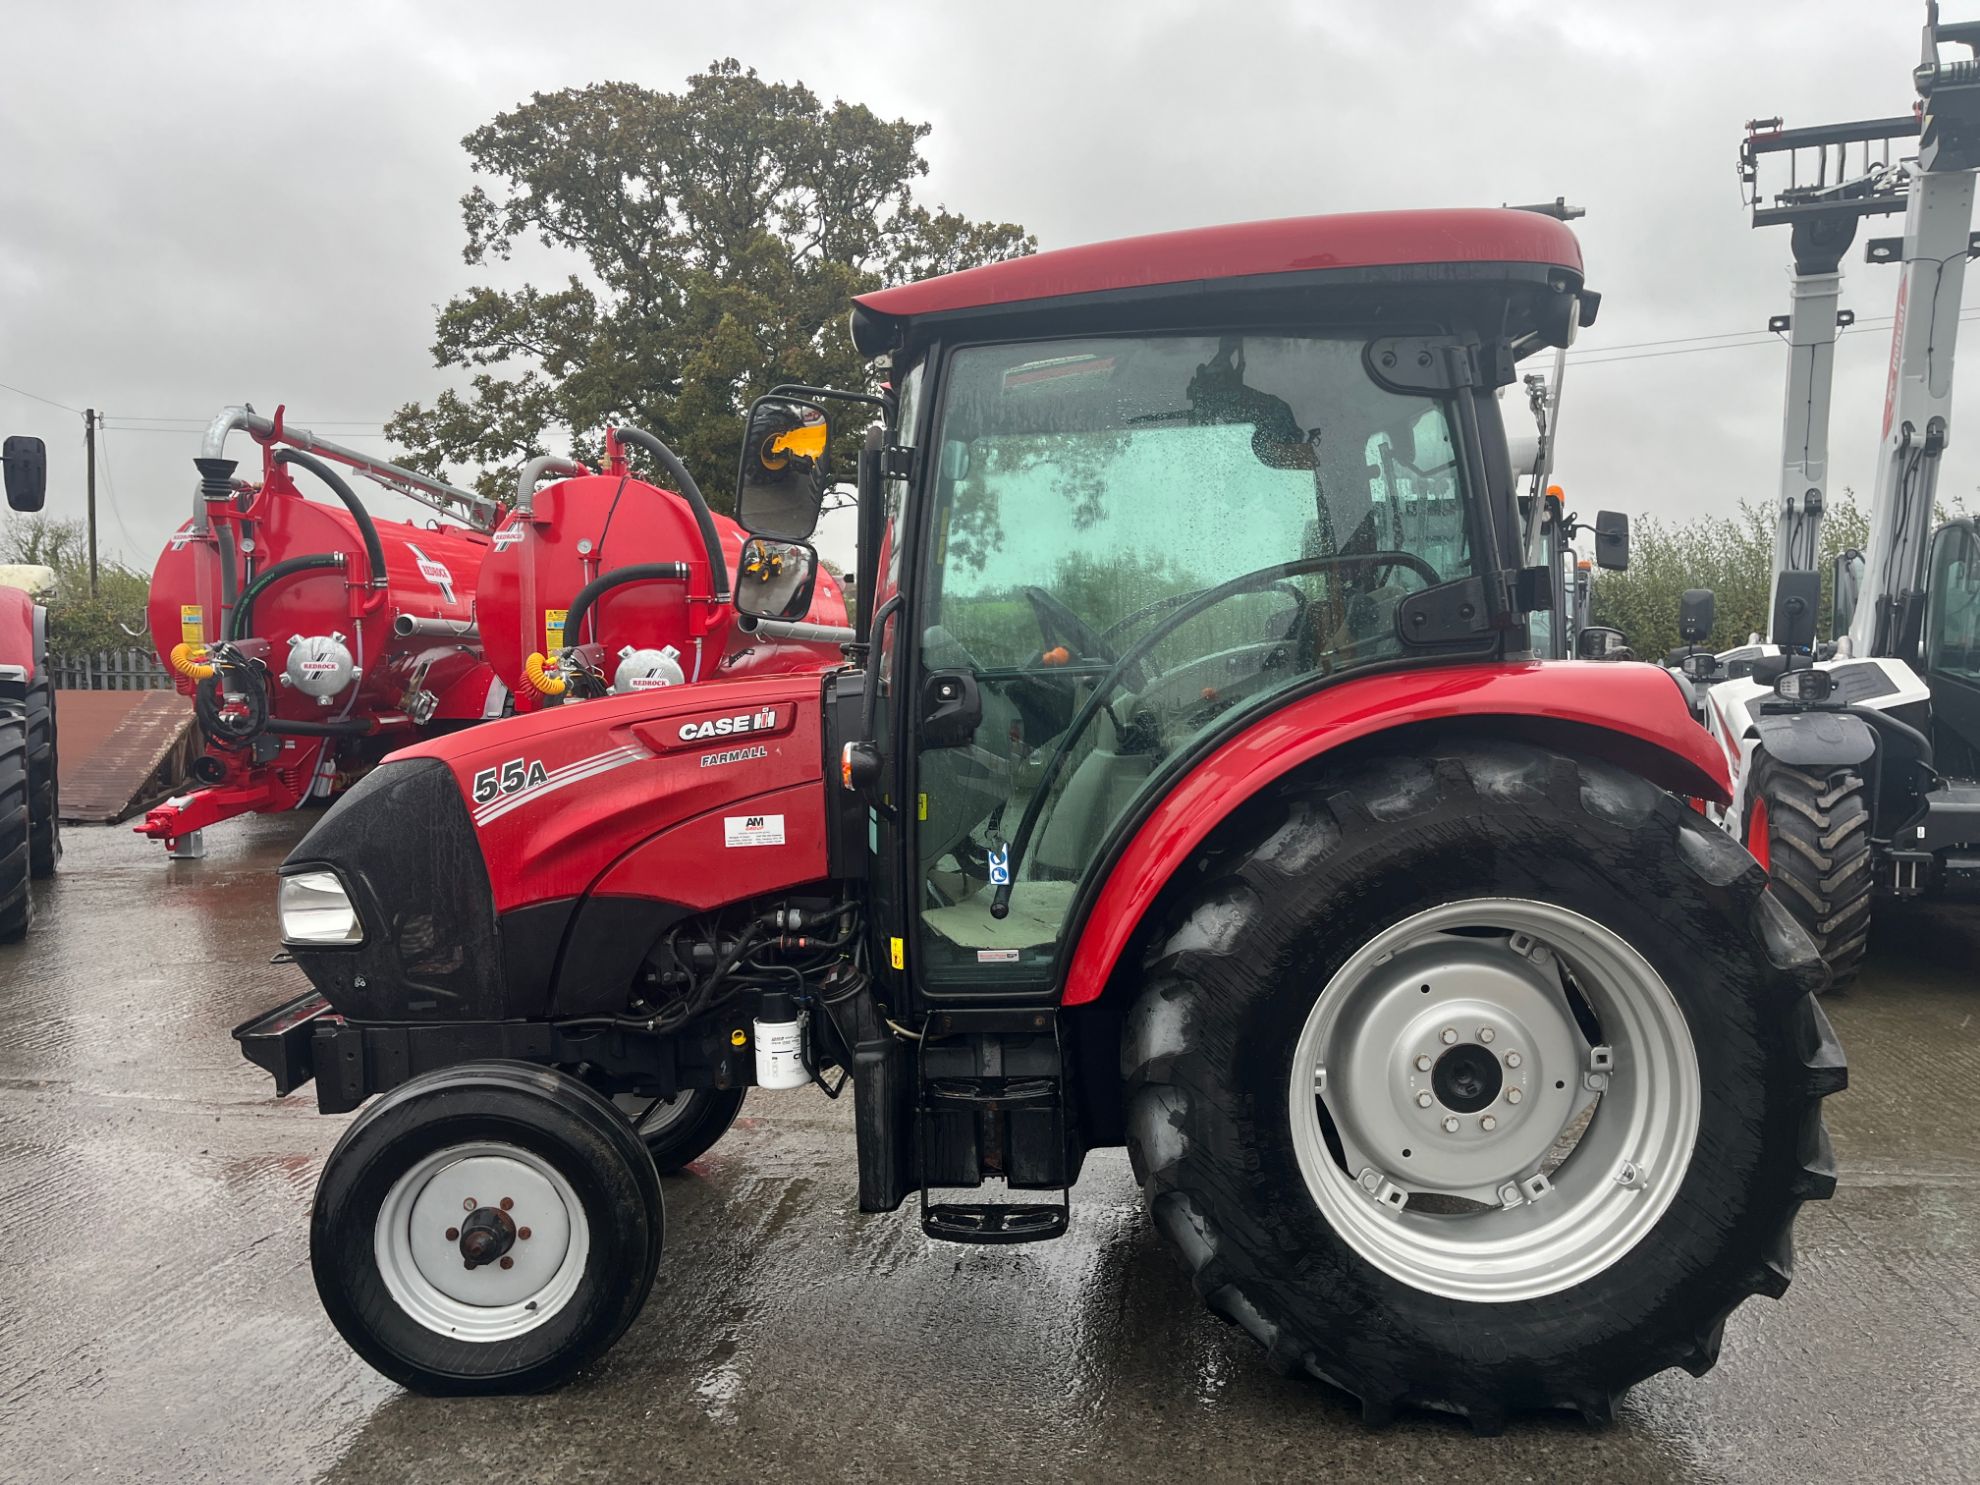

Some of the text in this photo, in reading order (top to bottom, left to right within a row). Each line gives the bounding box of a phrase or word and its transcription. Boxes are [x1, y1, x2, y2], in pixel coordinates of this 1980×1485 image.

[421, 564, 450, 579] REDROCK
[679, 714, 751, 741] CASE
[700, 745, 768, 768] FARMALL
[472, 757, 549, 804] 55A
[745, 816, 764, 827] AM
